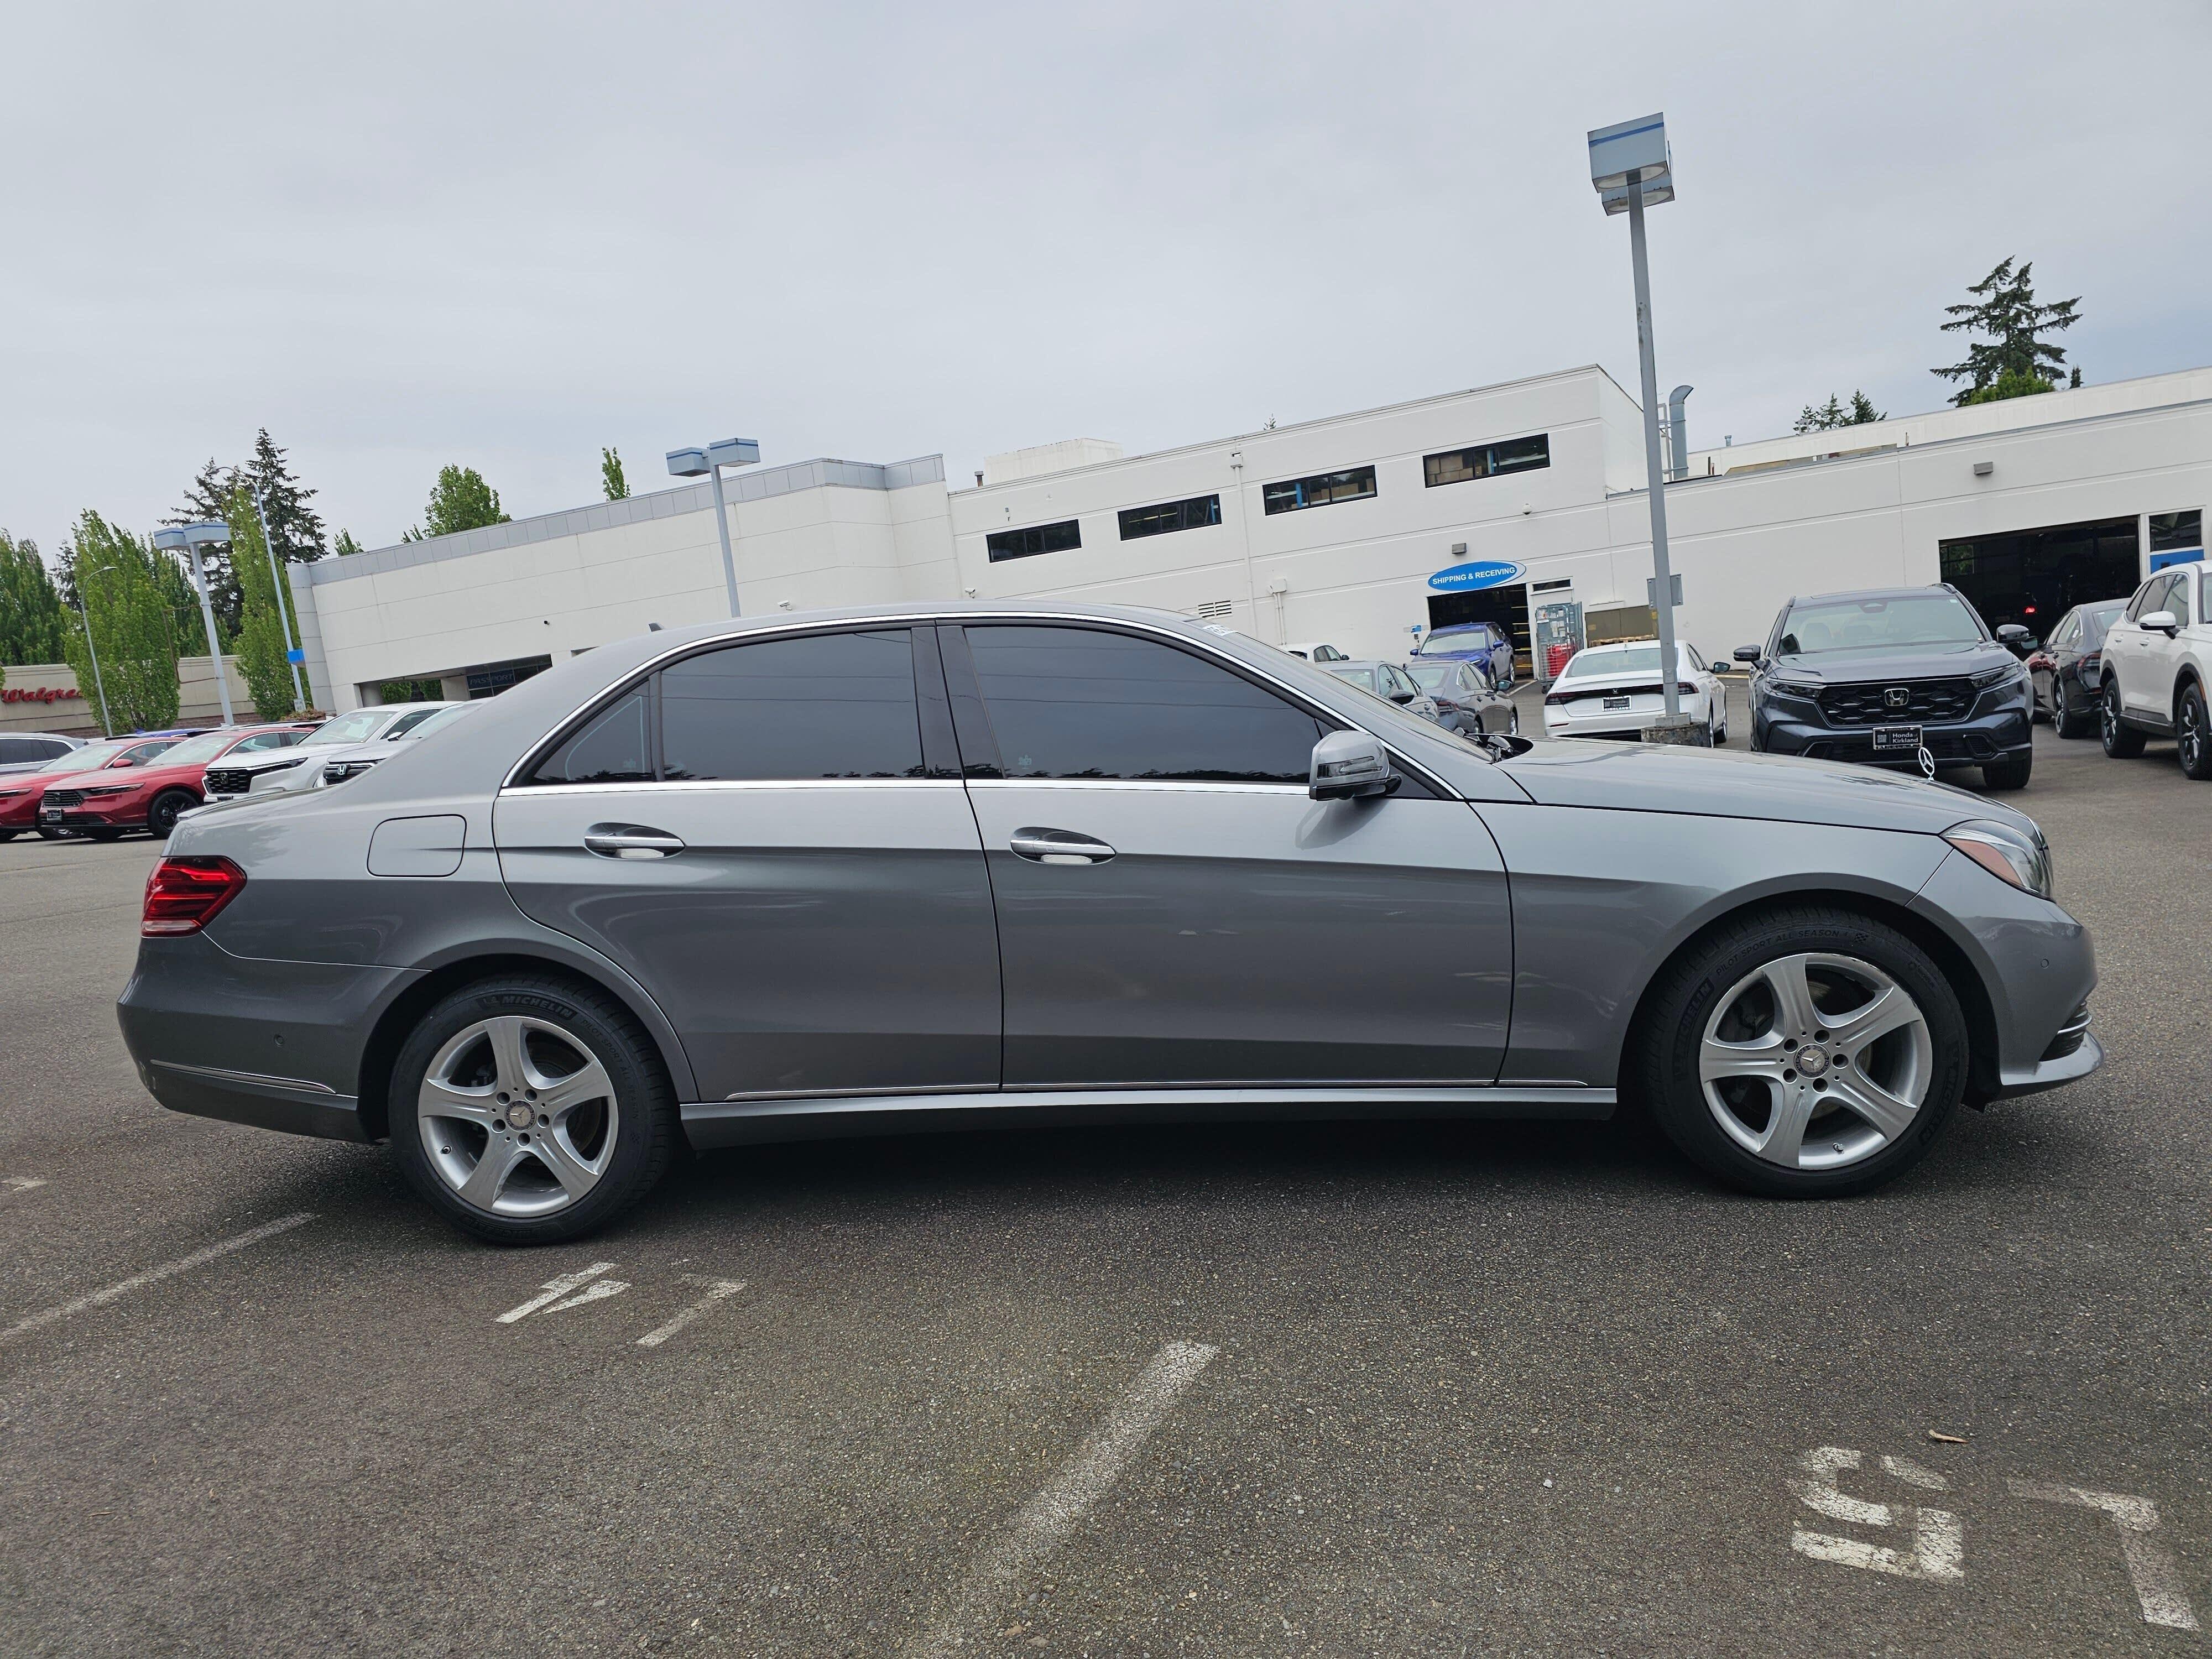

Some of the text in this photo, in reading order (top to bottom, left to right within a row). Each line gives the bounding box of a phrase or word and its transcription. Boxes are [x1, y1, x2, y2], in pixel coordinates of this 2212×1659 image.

[1432, 573, 1467, 585] SHIPPING
[1475, 567, 1516, 579] RECEIVING
[469, 674, 513, 685] PASSPORT
[1715, 954, 1741, 976] PILOT
[1741, 937, 1772, 957] SPORT
[1775, 932, 1792, 943] ALL
[1798, 929, 1840, 938] SEASON
[502, 994, 574, 1018] MICHELIN
[580, 1019, 603, 1040] PILOT
[601, 1039, 624, 1063] SPORT
